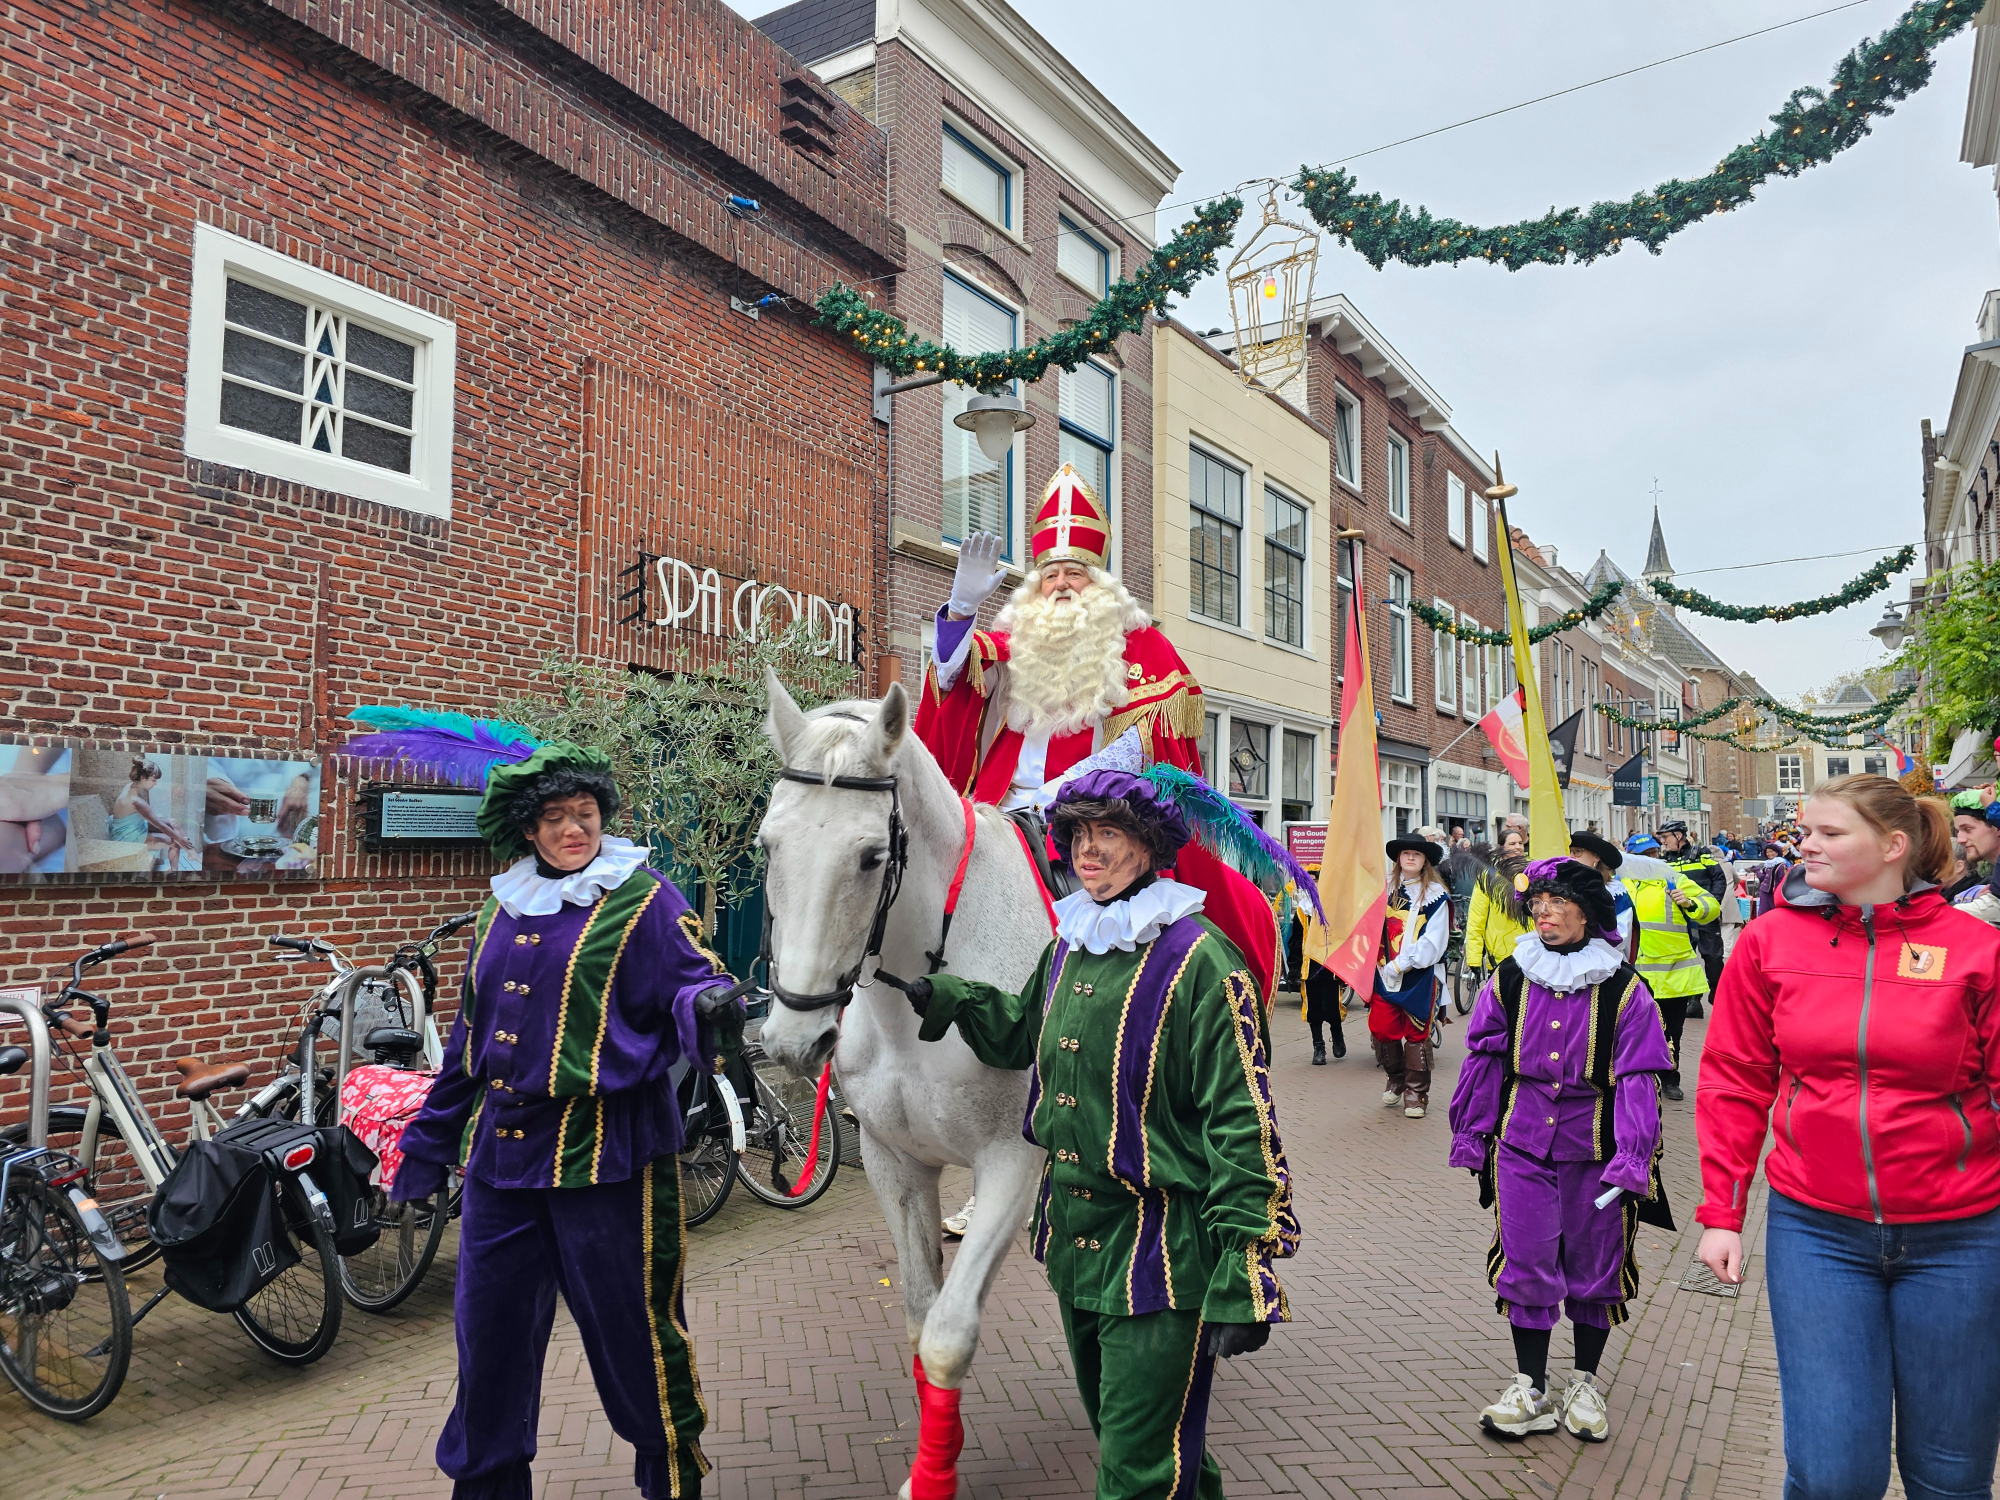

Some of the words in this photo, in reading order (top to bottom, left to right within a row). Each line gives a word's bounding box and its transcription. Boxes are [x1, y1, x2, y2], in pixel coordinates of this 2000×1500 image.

[656, 556, 721, 637] SPA
[733, 579, 853, 663] GOUDA
[1241, 752, 1250, 766] 85
[1292, 830, 1306, 838] Spa
[301, 1072, 310, 1125] Gazelle
